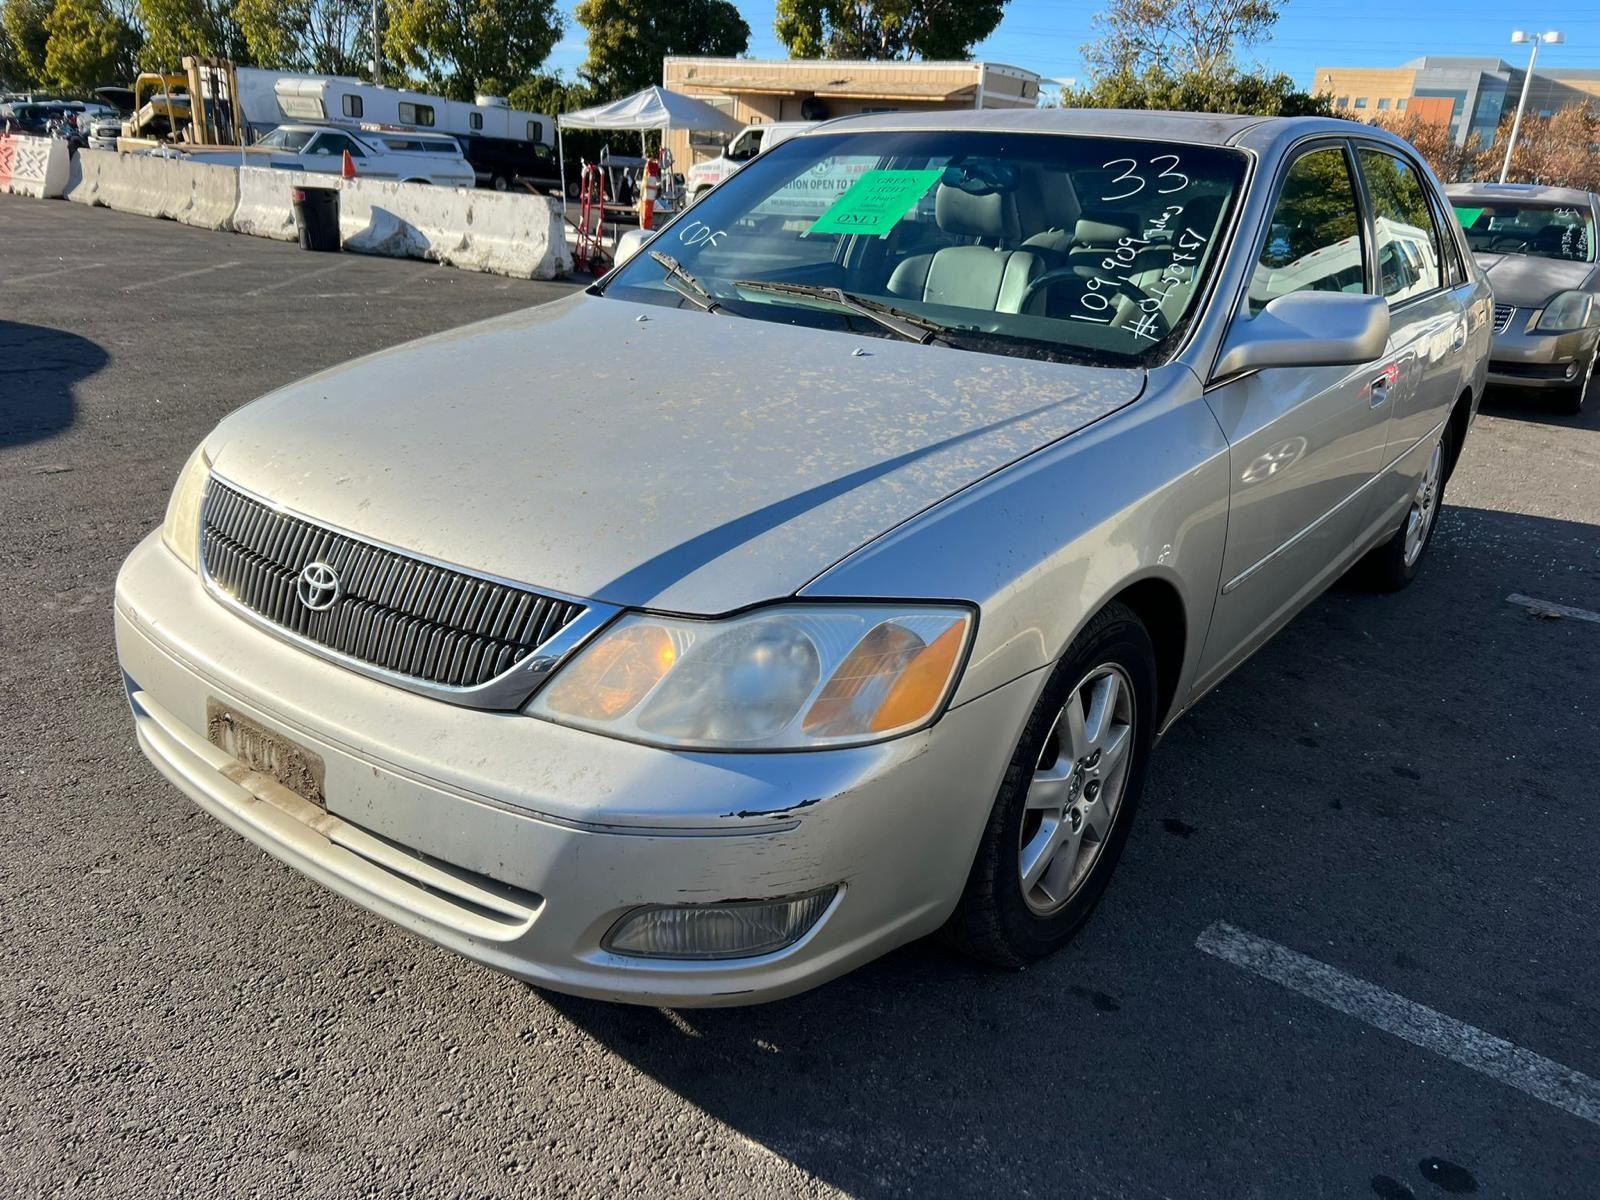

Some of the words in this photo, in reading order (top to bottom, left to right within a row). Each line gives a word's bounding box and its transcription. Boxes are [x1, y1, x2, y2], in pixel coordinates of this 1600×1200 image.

[810, 179, 835, 190] OPEN
[836, 179, 847, 189] TO
[1101, 154, 1189, 201] 33
[836, 214, 881, 224] ONLY
[1070, 236, 1151, 323] 109,909
